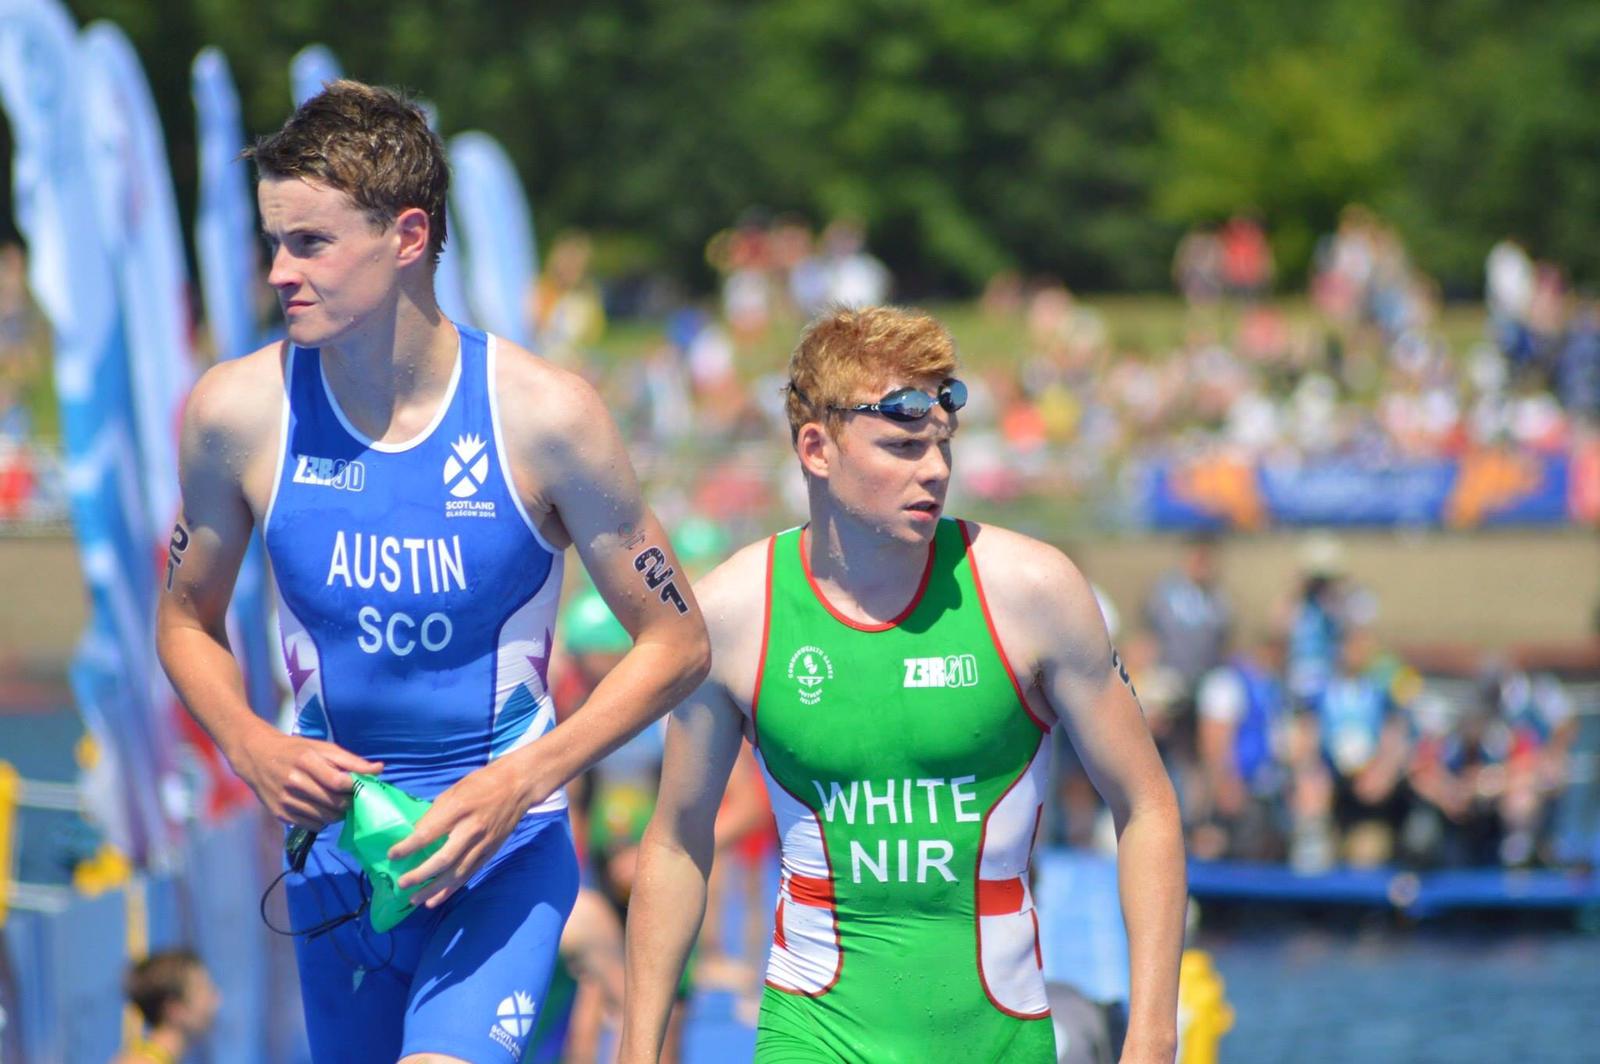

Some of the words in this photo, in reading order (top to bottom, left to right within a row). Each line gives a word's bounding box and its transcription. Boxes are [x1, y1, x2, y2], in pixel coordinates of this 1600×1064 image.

[445, 501, 495, 511] SCOTLAND
[445, 510, 478, 518] GLASGOW
[479, 511, 496, 519] 2014
[326, 530, 467, 594] AUSTIN
[634, 546, 689, 615] 21
[357, 605, 454, 657] SCO
[812, 775, 981, 825] WHITE
[850, 839, 958, 884] NIR
